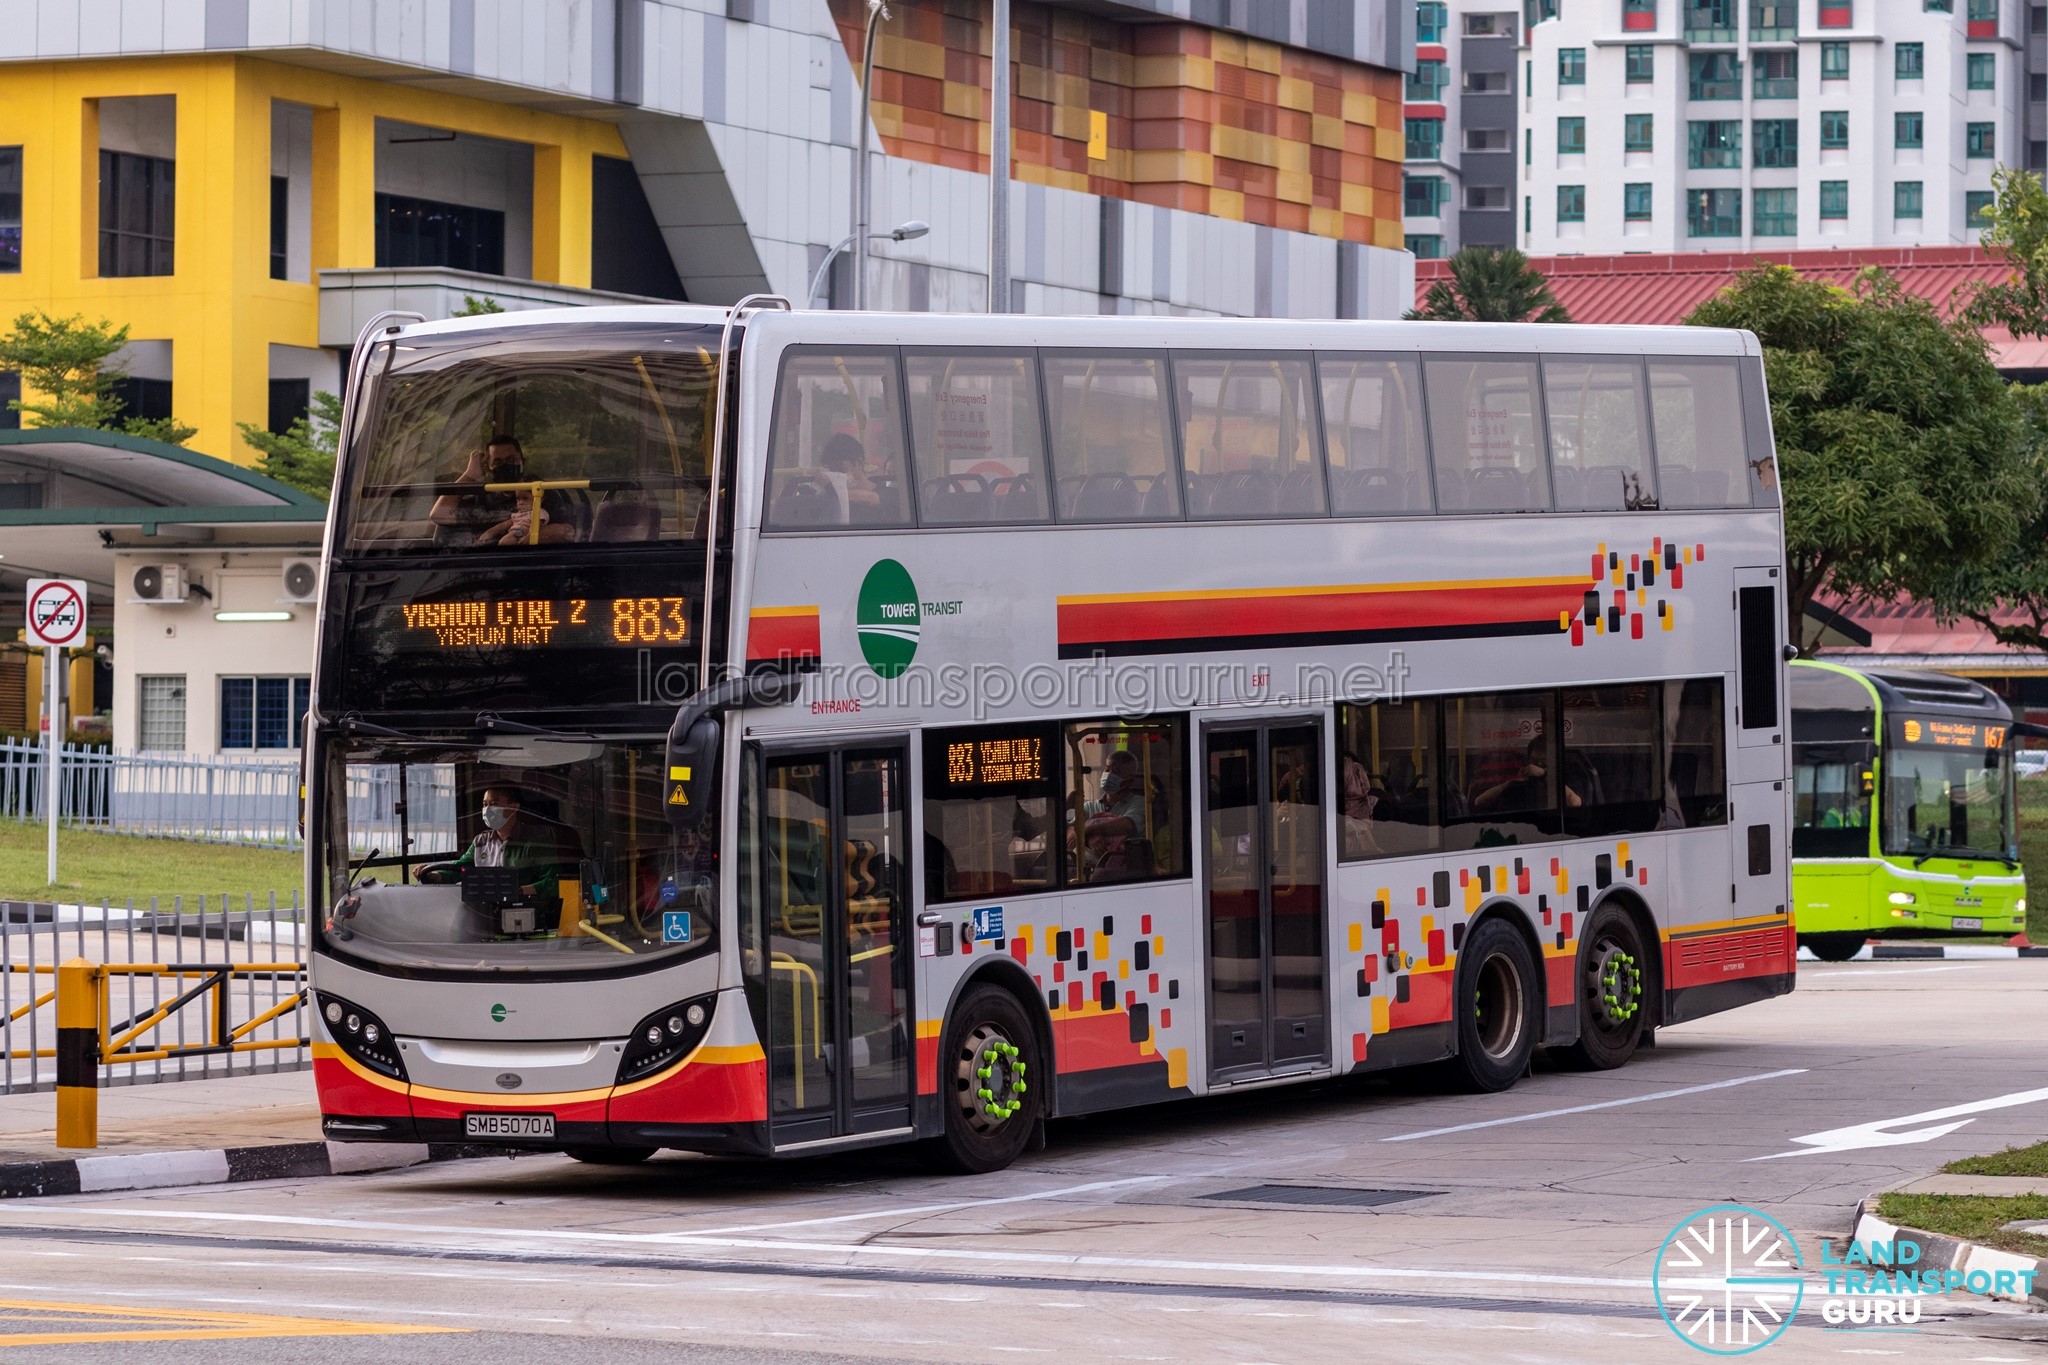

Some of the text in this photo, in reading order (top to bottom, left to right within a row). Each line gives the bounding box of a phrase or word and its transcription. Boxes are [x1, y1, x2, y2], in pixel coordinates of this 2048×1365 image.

[403, 600, 586, 628] YISHUN CTRL 2
[880, 601, 963, 618] TOWER TRANSIT
[613, 597, 685, 642] 883
[436, 626, 553, 646] YISHUN MRT
[1252, 674, 1270, 687] EXIT
[811, 699, 861, 715] ENTRANCE
[1984, 726, 2006, 749] 167
[468, 1117, 553, 1134] SMB5070A
